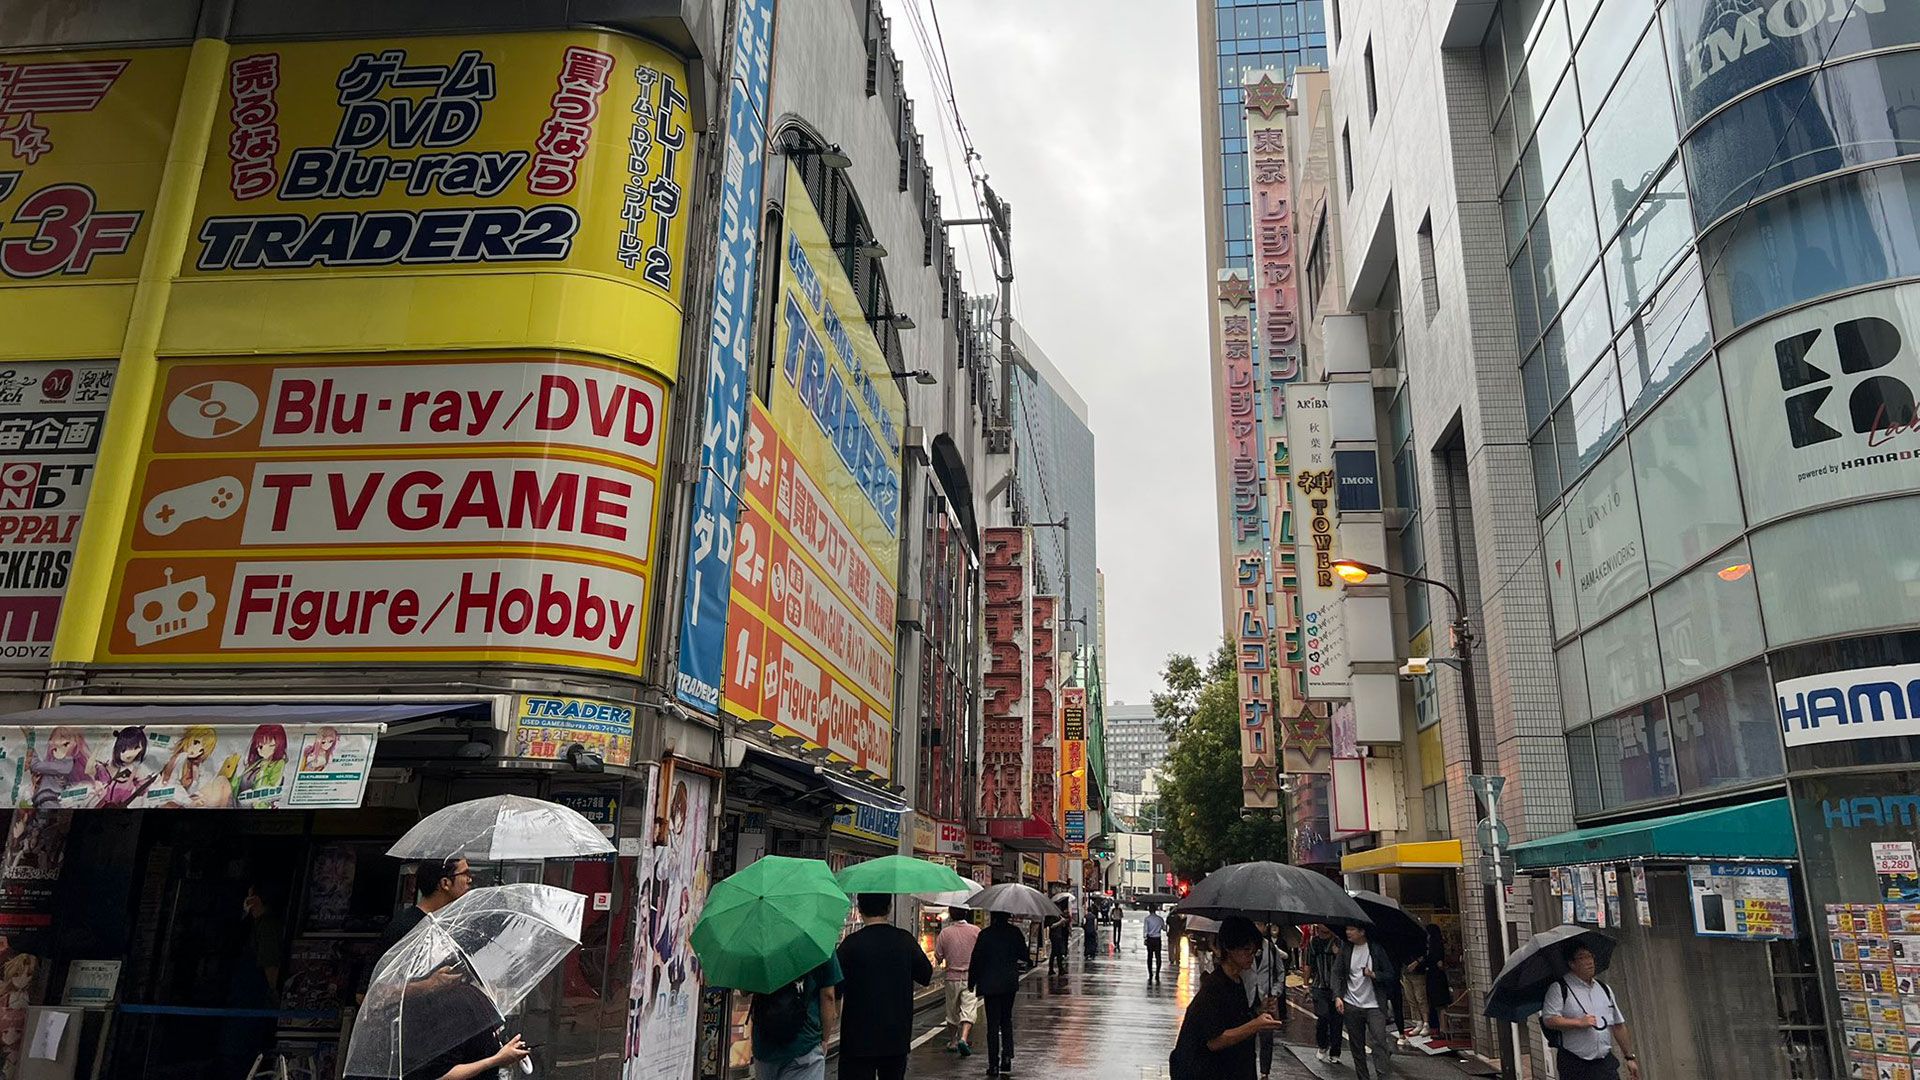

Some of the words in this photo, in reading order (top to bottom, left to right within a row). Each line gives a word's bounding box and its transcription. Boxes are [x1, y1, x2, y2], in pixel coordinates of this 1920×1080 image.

[337, 50, 496, 104] ゲーム
[229, 53, 280, 199] 売るなら
[335, 98, 482, 150] DVD
[527, 45, 615, 197] 買うなら
[196, 203, 581, 271] TRADER2
[787, 228, 822, 315] USED
[783, 288, 900, 540] TRADER2
[1224, 314, 1260, 543] 東京レジャーランド
[745, 422, 773, 489] 3F
[1341, 476, 1374, 485] IMON
[735, 522, 766, 588] 2F
[734, 627, 758, 690] 1F
[1238, 555, 1269, 751] ゲームコーナー
[525, 697, 633, 725] TRADER2
[678, 671, 719, 705] TRADER2
[779, 656, 818, 728] Figure
[517, 728, 539, 742] 3F
[521, 718, 540, 726] USED
[530, 740, 556, 758] 買取
[553, 730, 570, 741] 2F
[830, 693, 859, 754] GAME
[855, 804, 900, 840] TRADER2
[1756, 867, 1778, 876] HDD
